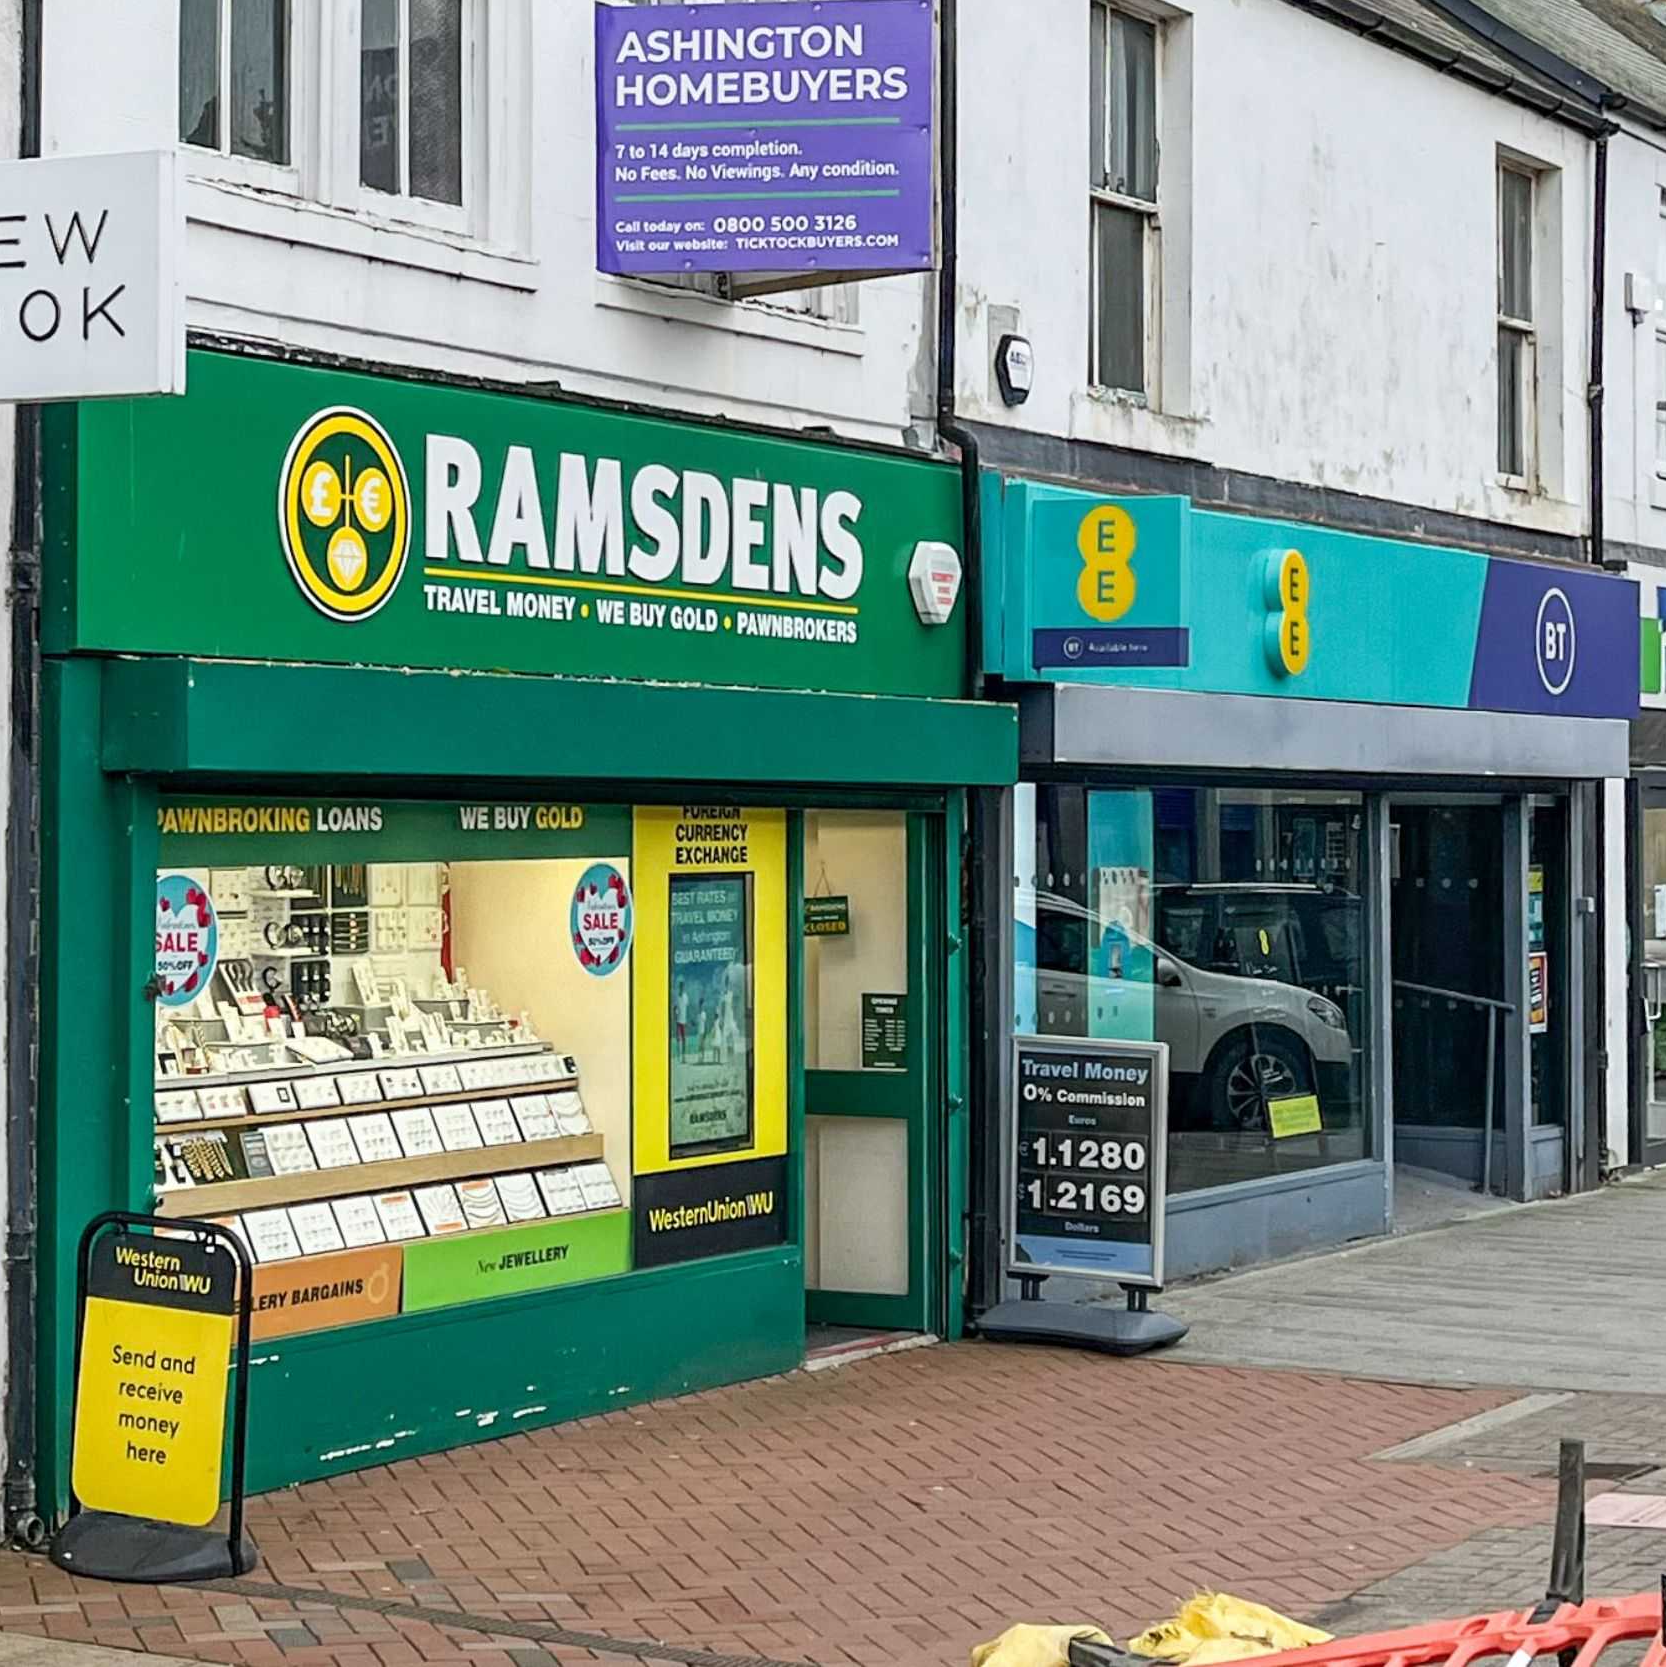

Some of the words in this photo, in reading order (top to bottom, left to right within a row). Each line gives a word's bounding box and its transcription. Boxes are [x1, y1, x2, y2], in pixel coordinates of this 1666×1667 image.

[615, 25, 863, 63] ASHINGTON
[615, 67, 908, 107] HOMEBUYERS
[615, 145, 625, 159] 7
[629, 145, 645, 159] to
[650, 144, 669, 158] 14
[672, 142, 708, 161] days
[712, 140, 803, 160] completion.
[615, 167, 637, 181] No
[640, 166, 681, 181] Fees.
[685, 165, 707, 179] No
[710, 162, 785, 182] Viewings.
[789, 162, 818, 181] Any
[822, 160, 899, 177] condition.
[615, 221, 640, 233] Call
[643, 220, 681, 234] today
[684, 222, 705, 232] on:
[713, 217, 765, 233] 0800
[770, 216, 808, 232] 500
[814, 215, 857, 231] 3126
[616, 240, 645, 252] Visit
[648, 241, 670, 251] our
[673, 239, 729, 251] website:
[735, 234, 898, 249] TICKTOCKBUYERS.COM
[424, 432, 864, 601] RAMSDENS
[423, 585, 502, 616] TRAVEL
[507, 592, 576, 622] MONEY
[596, 599, 625, 625] WE
[630, 602, 666, 629] BUY
[670, 605, 718, 633] GOLD
[736, 611, 857, 644] PAWNBROKERS
[1545, 621, 1566, 661] BT
[317, 807, 382, 831] LOANS
[460, 807, 489, 830] WE
[493, 806, 531, 829] BUY
[535, 805, 582, 829] GOLD
[676, 824, 748, 842] CURRENCY
[676, 846, 748, 864] EXCHANGE
[583, 912, 618, 931] SALE
[1022, 1059, 1079, 1078] Travel
[1084, 1062, 1149, 1085] Money
[1023, 1084, 1052, 1102] 0%
[1057, 1089, 1145, 1107] Commission
[1032, 1137, 1145, 1170] 1.1280
[1028, 1179, 1145, 1214] 1.2169
[115, 1246, 181, 1272] Western
[498, 1244, 570, 1271] JEWELLERY
[134, 1270, 178, 1291] Union
[291, 1279, 364, 1305] BARGAINS
[112, 1345, 156, 1370] Send
[161, 1355, 195, 1375] and
[119, 1381, 183, 1404] receive
[119, 1412, 180, 1438] money
[126, 1441, 167, 1465] here
